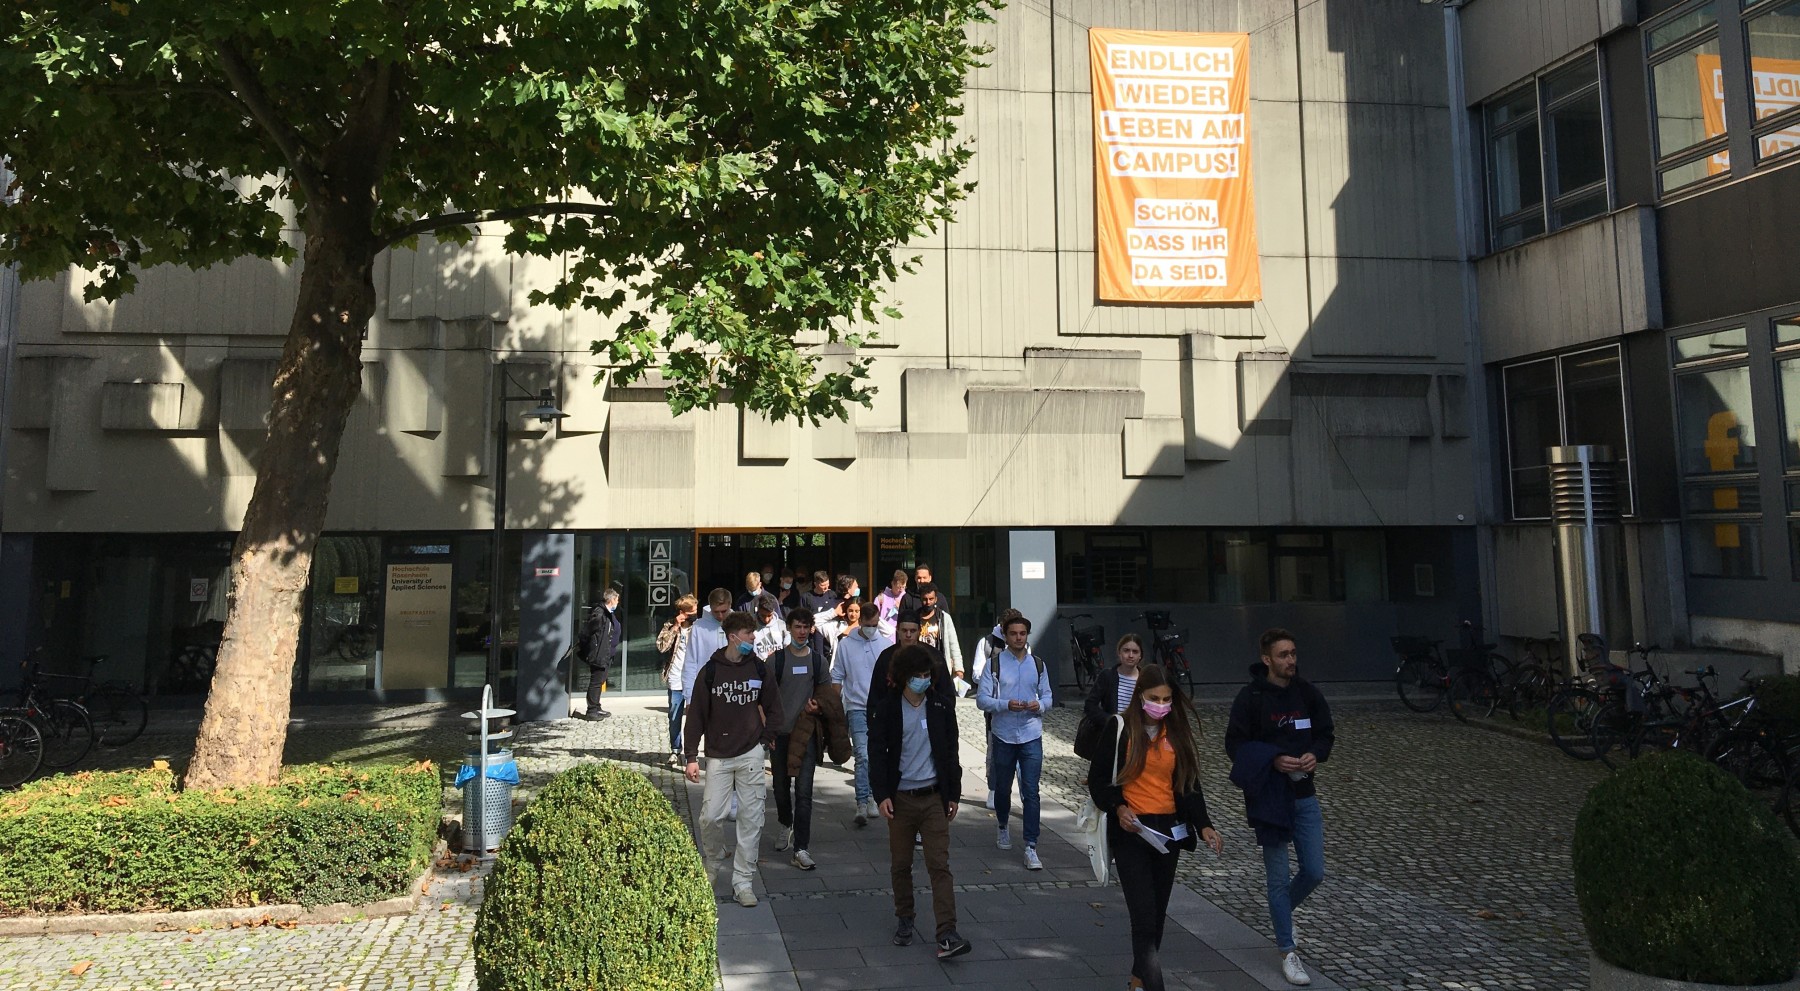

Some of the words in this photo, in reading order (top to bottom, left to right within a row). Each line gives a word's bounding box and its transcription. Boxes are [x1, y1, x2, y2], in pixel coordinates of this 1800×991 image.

[1110, 49, 1231, 72] ENDLICH
[1118, 82, 1227, 106] WIEDER
[1103, 115, 1194, 139] LEBEN
[1202, 118, 1242, 140] AM
[1112, 150, 1237, 174] CAMPUS!
[1137, 202, 1217, 224] SCHÖN,
[1129, 233, 1185, 251] DASS
[1192, 234, 1226, 251] IHR
[1134, 264, 1163, 280] DA
[1170, 264, 1224, 281] SEID.
[652, 542, 668, 558] A
[652, 564, 667, 581] B
[391, 578, 424, 586] University
[652, 586, 667, 603] C
